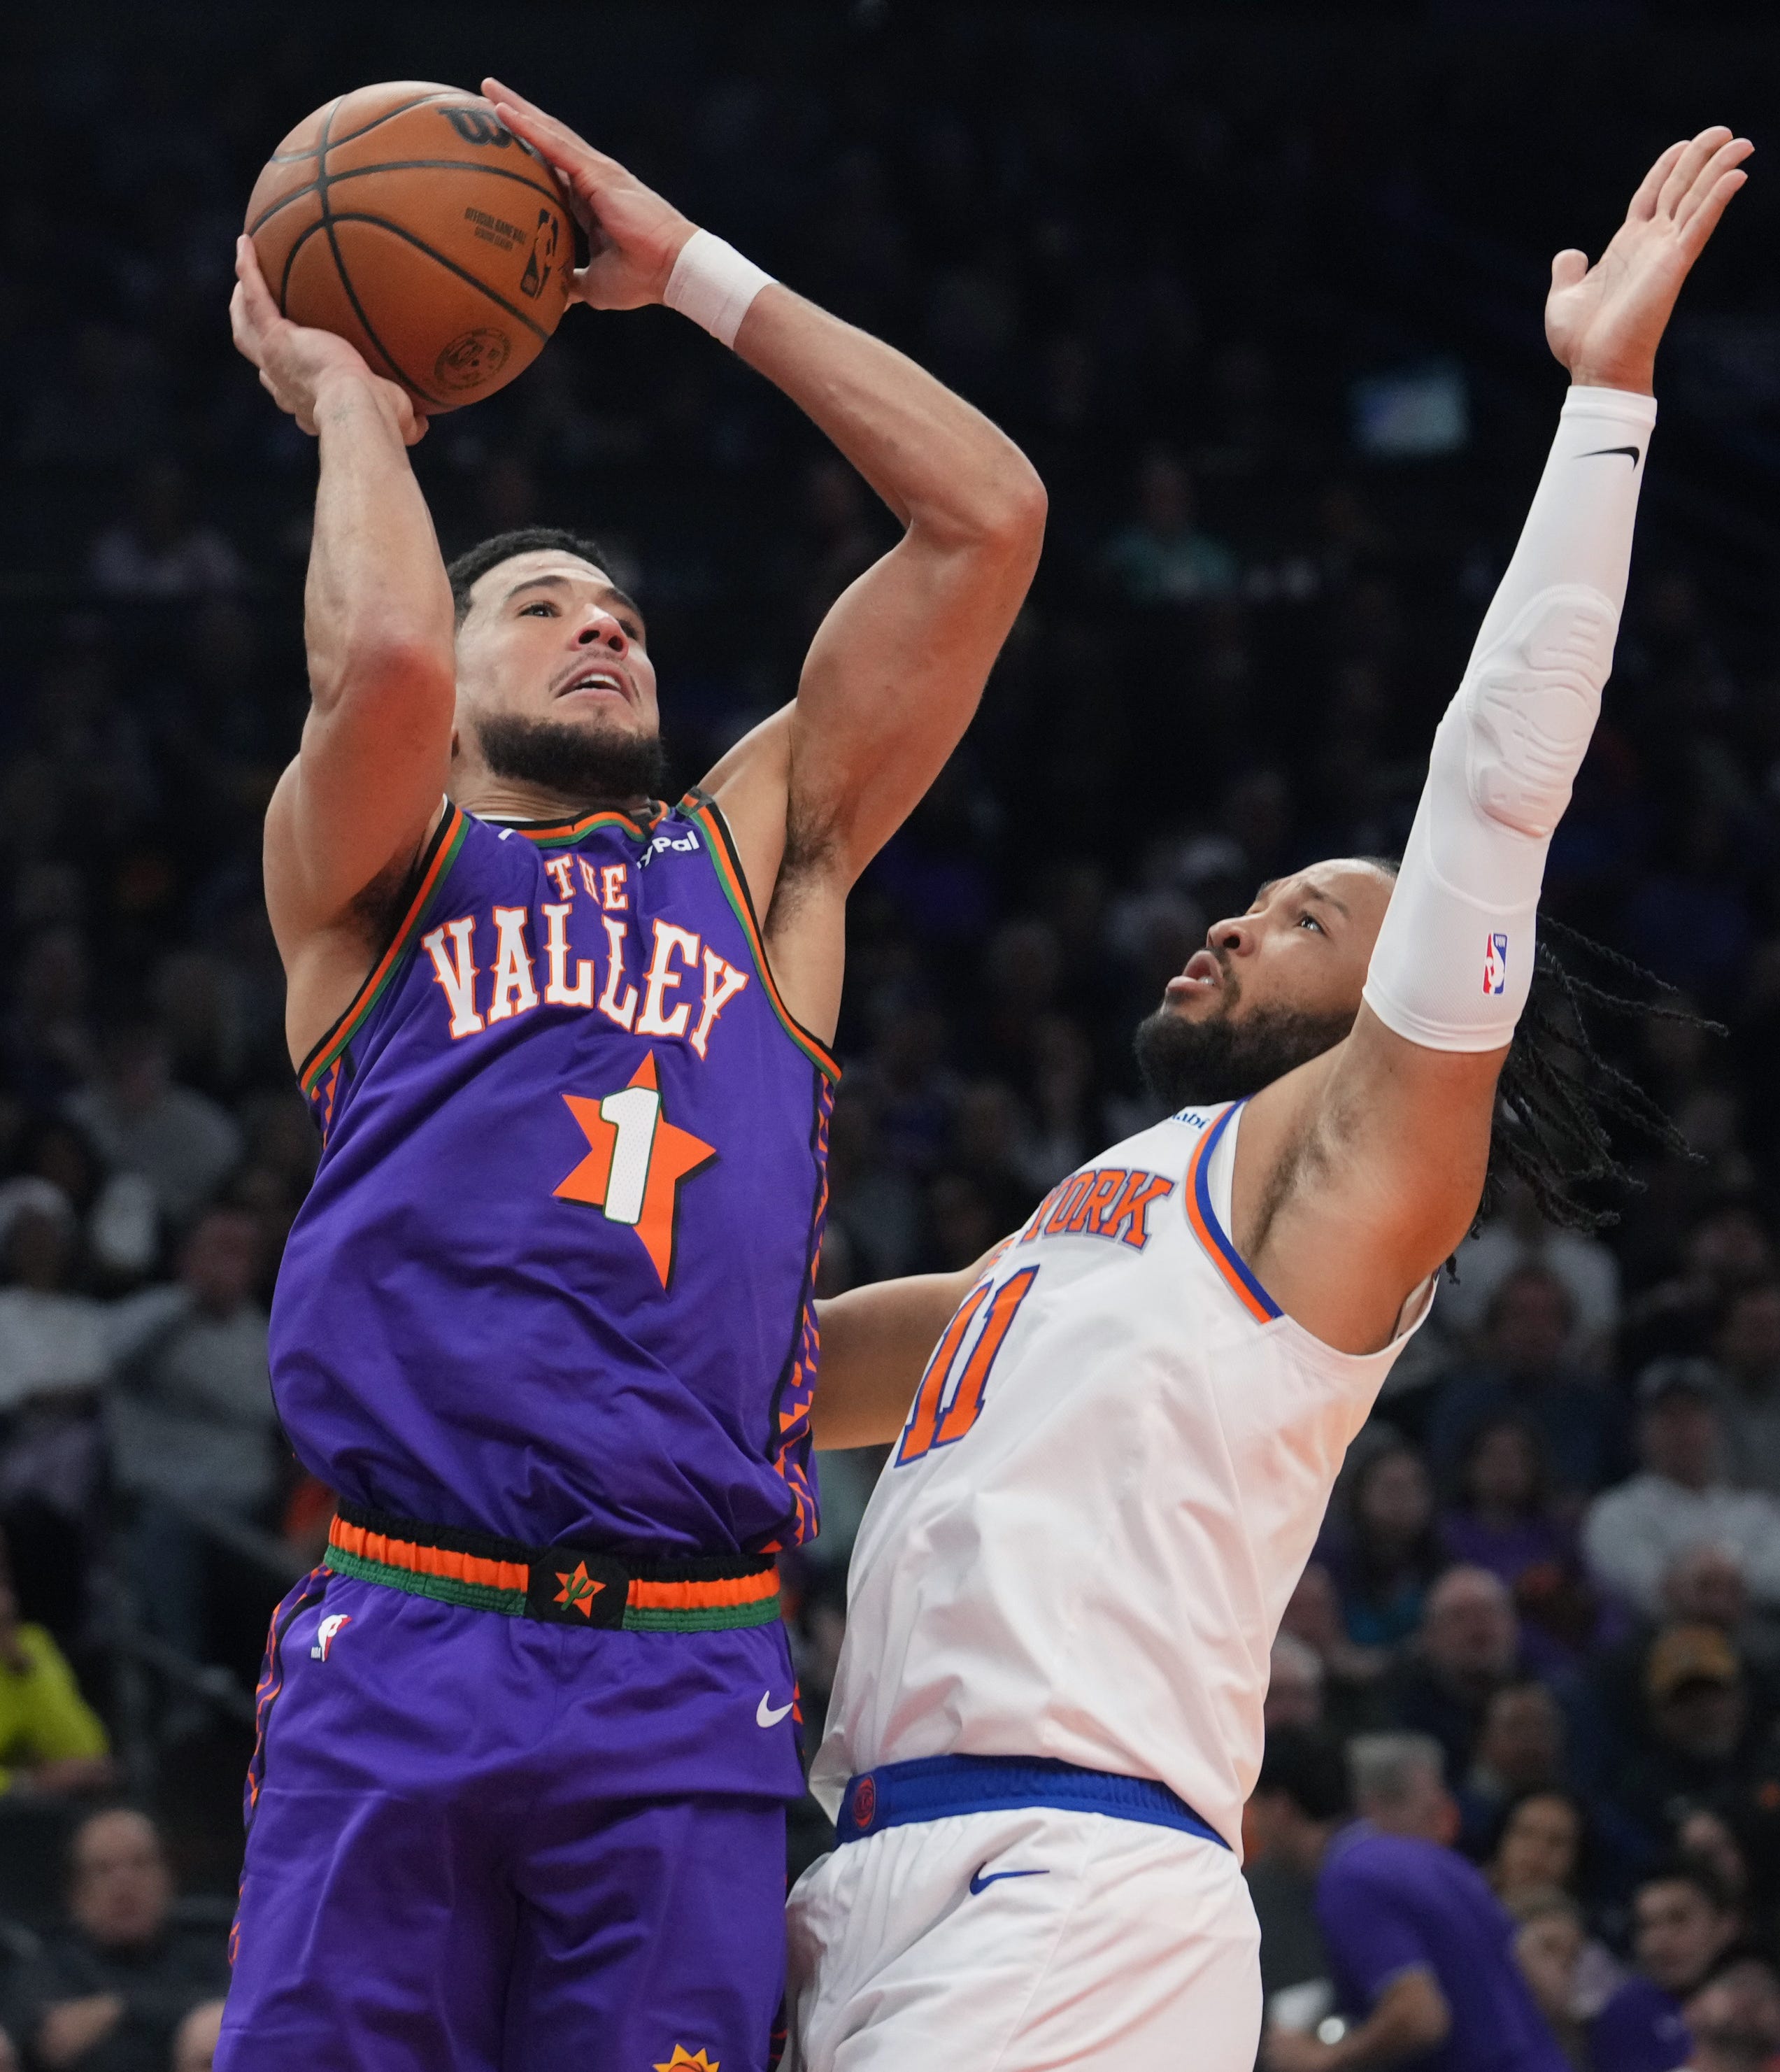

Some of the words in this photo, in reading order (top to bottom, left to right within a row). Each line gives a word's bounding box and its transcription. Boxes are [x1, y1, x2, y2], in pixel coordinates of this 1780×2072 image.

[545, 853, 628, 911] THE
[636, 830, 700, 870] yPal
[421, 902, 750, 1061] VALLEY
[599, 1085, 661, 1226] 1
[893, 1264, 1041, 1468] 11
